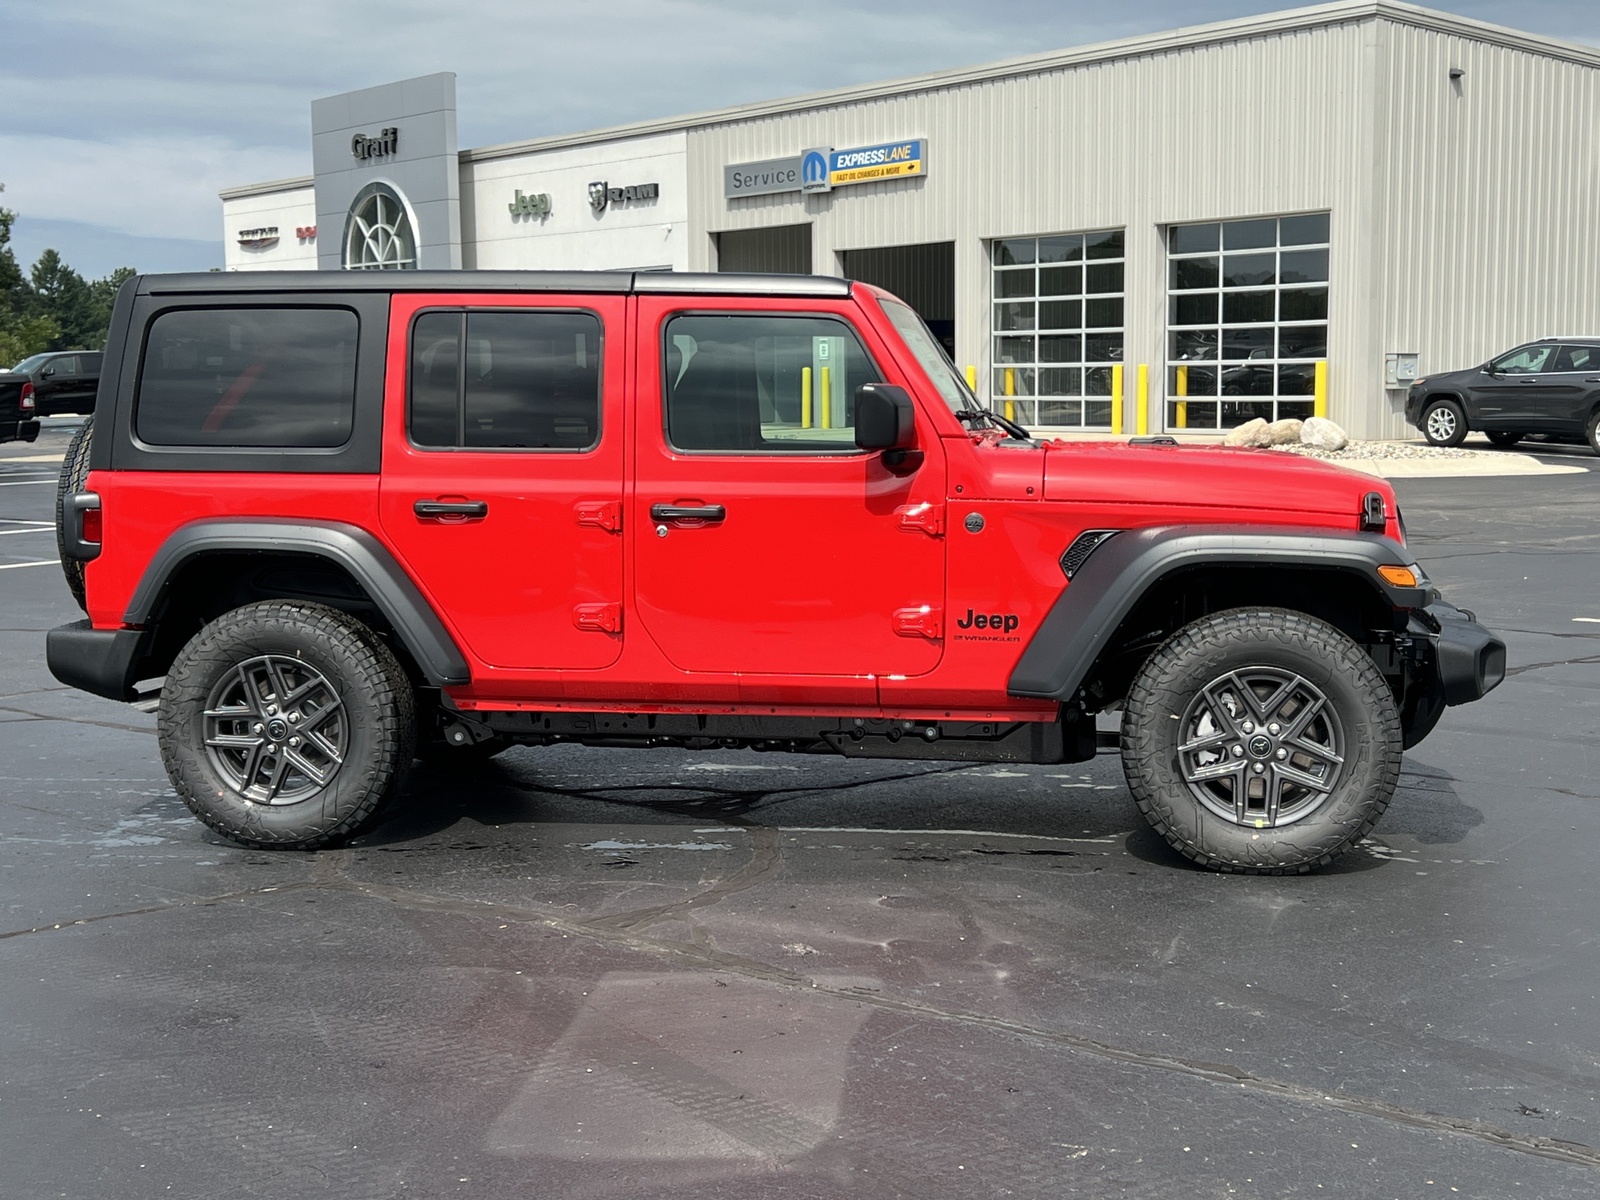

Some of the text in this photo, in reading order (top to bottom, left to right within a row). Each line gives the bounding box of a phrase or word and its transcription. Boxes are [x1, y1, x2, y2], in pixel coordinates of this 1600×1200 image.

[351, 127, 398, 160] Graff
[837, 145, 912, 168] EXPRESSLANE
[732, 167, 796, 189] Service
[836, 173, 848, 182] FAST
[857, 170, 880, 180] CHANGES
[886, 167, 900, 175] MORE
[508, 189, 551, 218] Jeep
[607, 183, 659, 202] RAM
[957, 608, 1019, 634] Jeep
[1330, 722, 1370, 825] NEXEN
